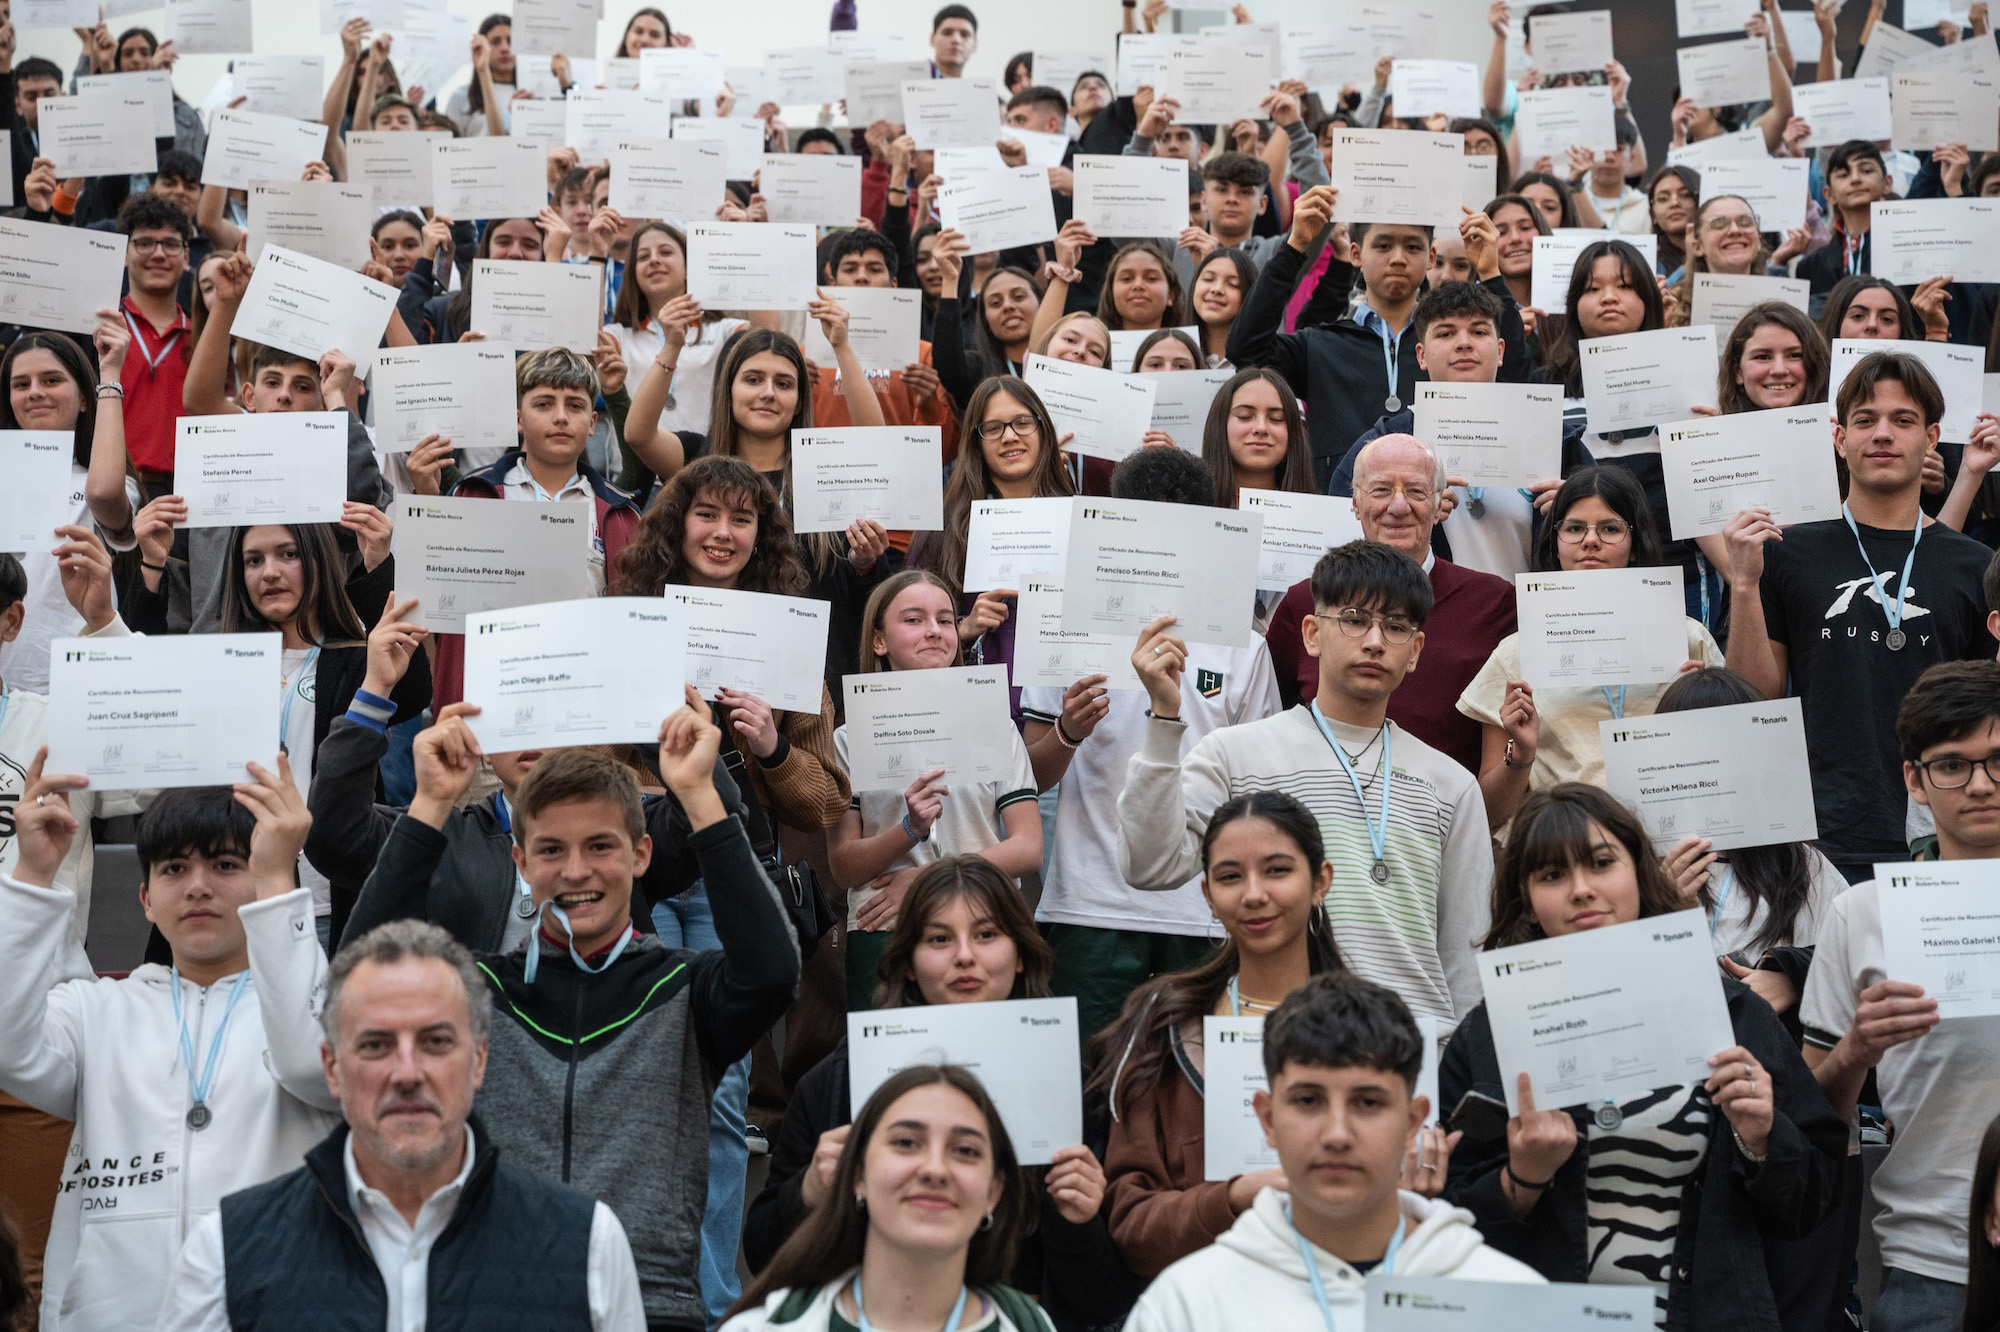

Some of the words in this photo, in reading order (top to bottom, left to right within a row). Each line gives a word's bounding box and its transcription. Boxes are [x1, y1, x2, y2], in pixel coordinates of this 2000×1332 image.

[1438, 141, 1454, 149] Tenaris
[1354, 174, 1376, 182] Emanuel
[1377, 175, 1394, 183] Huang
[368, 289, 386, 300] Tenaris
[268, 294, 279, 303] Ciro
[280, 299, 298, 308] Muñoz
[1953, 354, 1973, 362] Tenaris
[1632, 378, 1650, 386] Huang
[395, 398, 406, 406] José
[407, 397, 427, 405] Ignacio
[438, 395, 452, 403] Nally
[1794, 416, 1817, 425] Tenaris
[1437, 433, 1452, 441] Alejo
[33, 443, 59, 452] Tenaris
[1690, 458, 1716, 466] Certificado
[1723, 452, 1760, 461] Reconocimiento
[202, 469, 229, 477] Stefanía
[1693, 476, 1707, 484] Axel
[1708, 474, 1734, 482] Quimey
[1735, 470, 1758, 478] Rupani
[834, 477, 862, 485] Mercedes
[426, 511, 446, 519] Roberto
[549, 515, 574, 524] Tenaris
[1101, 513, 1121, 521] Roberto
[1223, 524, 1248, 532] Tenaris
[426, 543, 454, 552] Certificado
[463, 545, 504, 554] Reconocimiento
[1262, 538, 1281, 546] Ámbar
[1282, 540, 1301, 549] Camila
[1303, 542, 1321, 551] Fleitas
[1098, 545, 1126, 553] Certificado
[1135, 548, 1176, 556] Reconocimiento
[426, 564, 454, 572] Bárbara
[455, 565, 480, 574] Julieta
[482, 566, 502, 575] Pérez
[504, 568, 524, 576] Rojas
[1096, 565, 1130, 574] Francisco
[1132, 568, 1159, 576] Santino
[1161, 570, 1179, 578] Ricci
[1649, 579, 1671, 587] Tenaris
[796, 610, 817, 618] Tenaris
[1039, 629, 1058, 637] Mateo
[1059, 629, 1088, 638] Quinteros
[1821, 626, 1930, 647] RUSY
[687, 640, 703, 649] Sofía
[704, 642, 718, 651] Rive
[234, 649, 264, 658] Tenaris
[499, 678, 519, 687] Juan
[521, 676, 546, 684] Diego
[548, 673, 570, 681] Raffo
[974, 677, 995, 685] Tenaris
[87, 689, 122, 697] Certificado
[132, 687, 181, 695] Reconocimiento
[87, 712, 108, 720] Juan
[110, 711, 131, 719] Cruz
[133, 710, 177, 720] Sagripanti
[1760, 715, 1787, 724] Tenaris
[873, 730, 896, 739] Delfina
[897, 729, 912, 737] Soto
[913, 727, 935, 736] Dovale
[1637, 765, 1667, 773] Certificado
[1675, 759, 1719, 767] Reconocimiento
[1640, 786, 1669, 794] Victoria
[1671, 783, 1697, 791] Milena
[1699, 779, 1717, 787] Ricci
[1662, 931, 1693, 941] Tenaris
[1923, 939, 1960, 947] Máximo
[1961, 936, 1995, 945] Gabriel
[1030, 1017, 1060, 1026] Tenaris
[1533, 1023, 1566, 1036] Anahel
[1565, 1019, 1587, 1029] Roth
